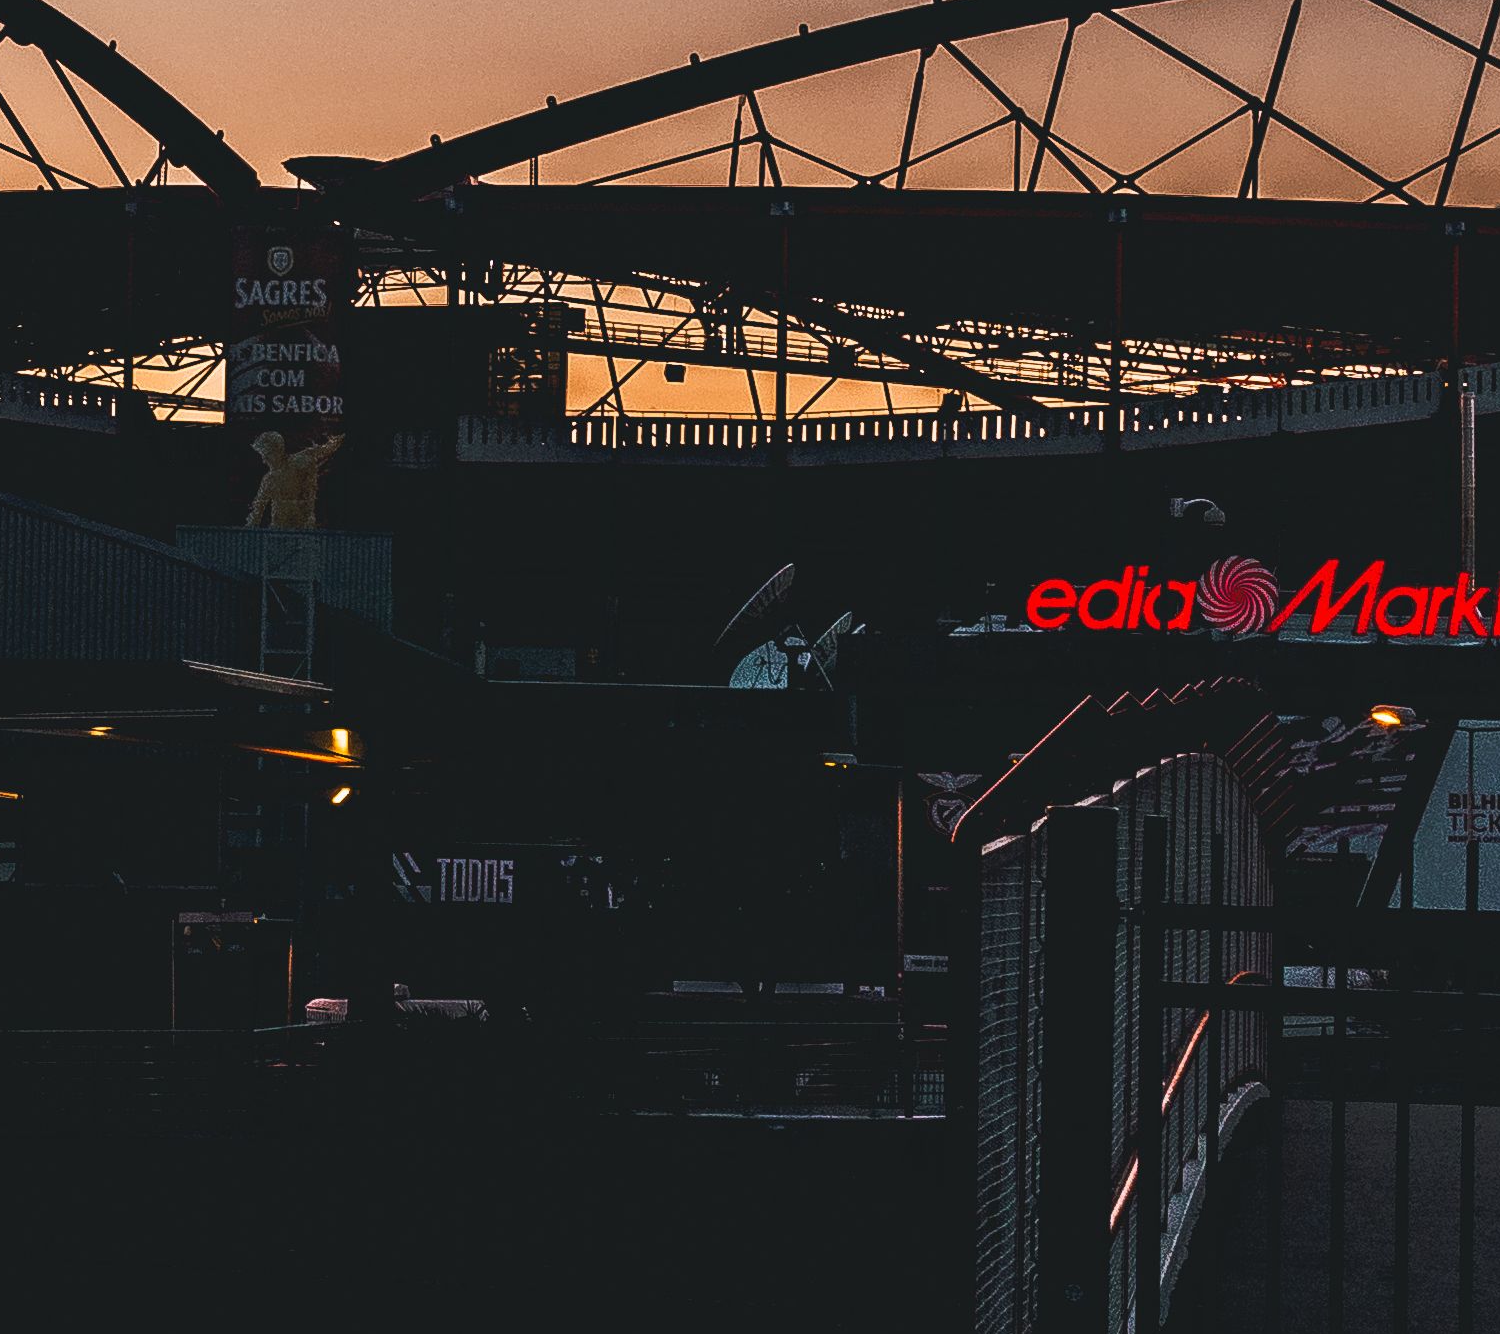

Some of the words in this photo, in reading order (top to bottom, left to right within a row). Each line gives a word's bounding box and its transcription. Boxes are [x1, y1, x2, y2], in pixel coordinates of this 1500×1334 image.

[234, 277, 327, 309] SAGRES
[252, 343, 340, 363] BENFICA
[257, 369, 305, 388] COM
[272, 395, 344, 415] SABOR
[436, 858, 514, 904] TODOS
